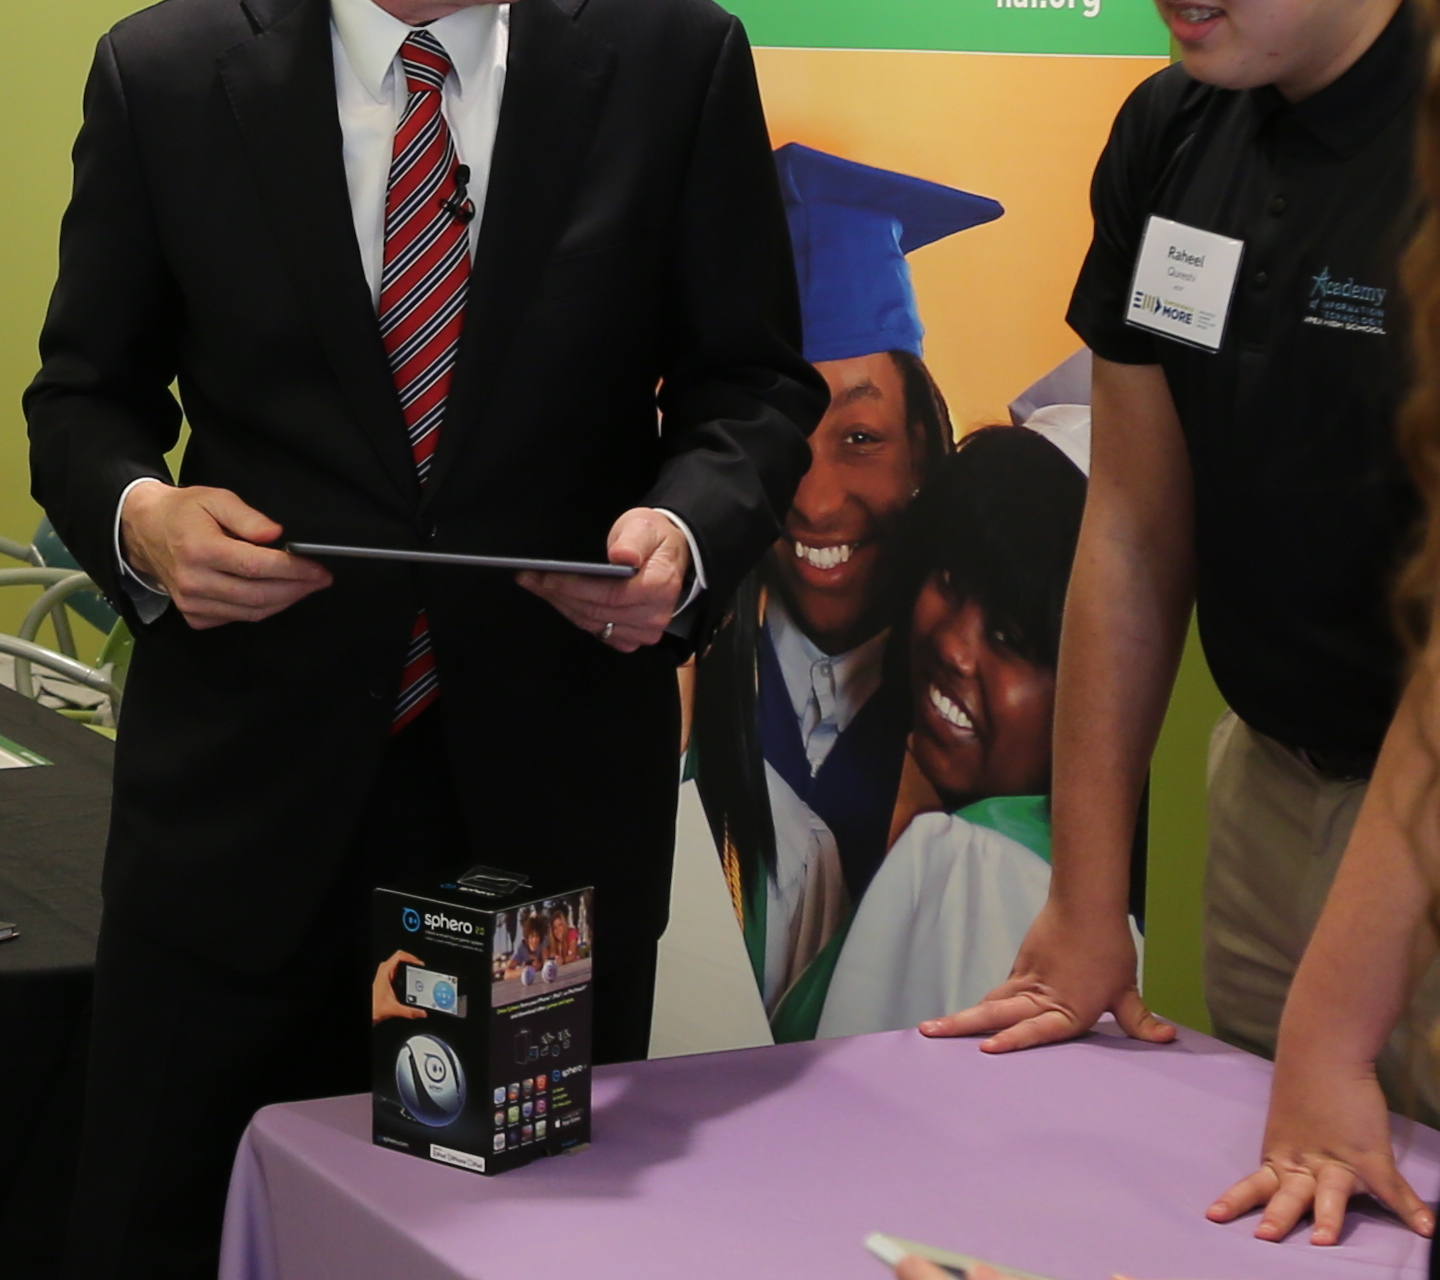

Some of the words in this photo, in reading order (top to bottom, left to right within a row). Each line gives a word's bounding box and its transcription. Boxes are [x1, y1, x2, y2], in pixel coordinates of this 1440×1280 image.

[1167, 245, 1206, 269] Raheel
[1310, 265, 1387, 307] Academy
[1161, 305, 1194, 326] MORE
[423, 912, 473, 936] sphero
